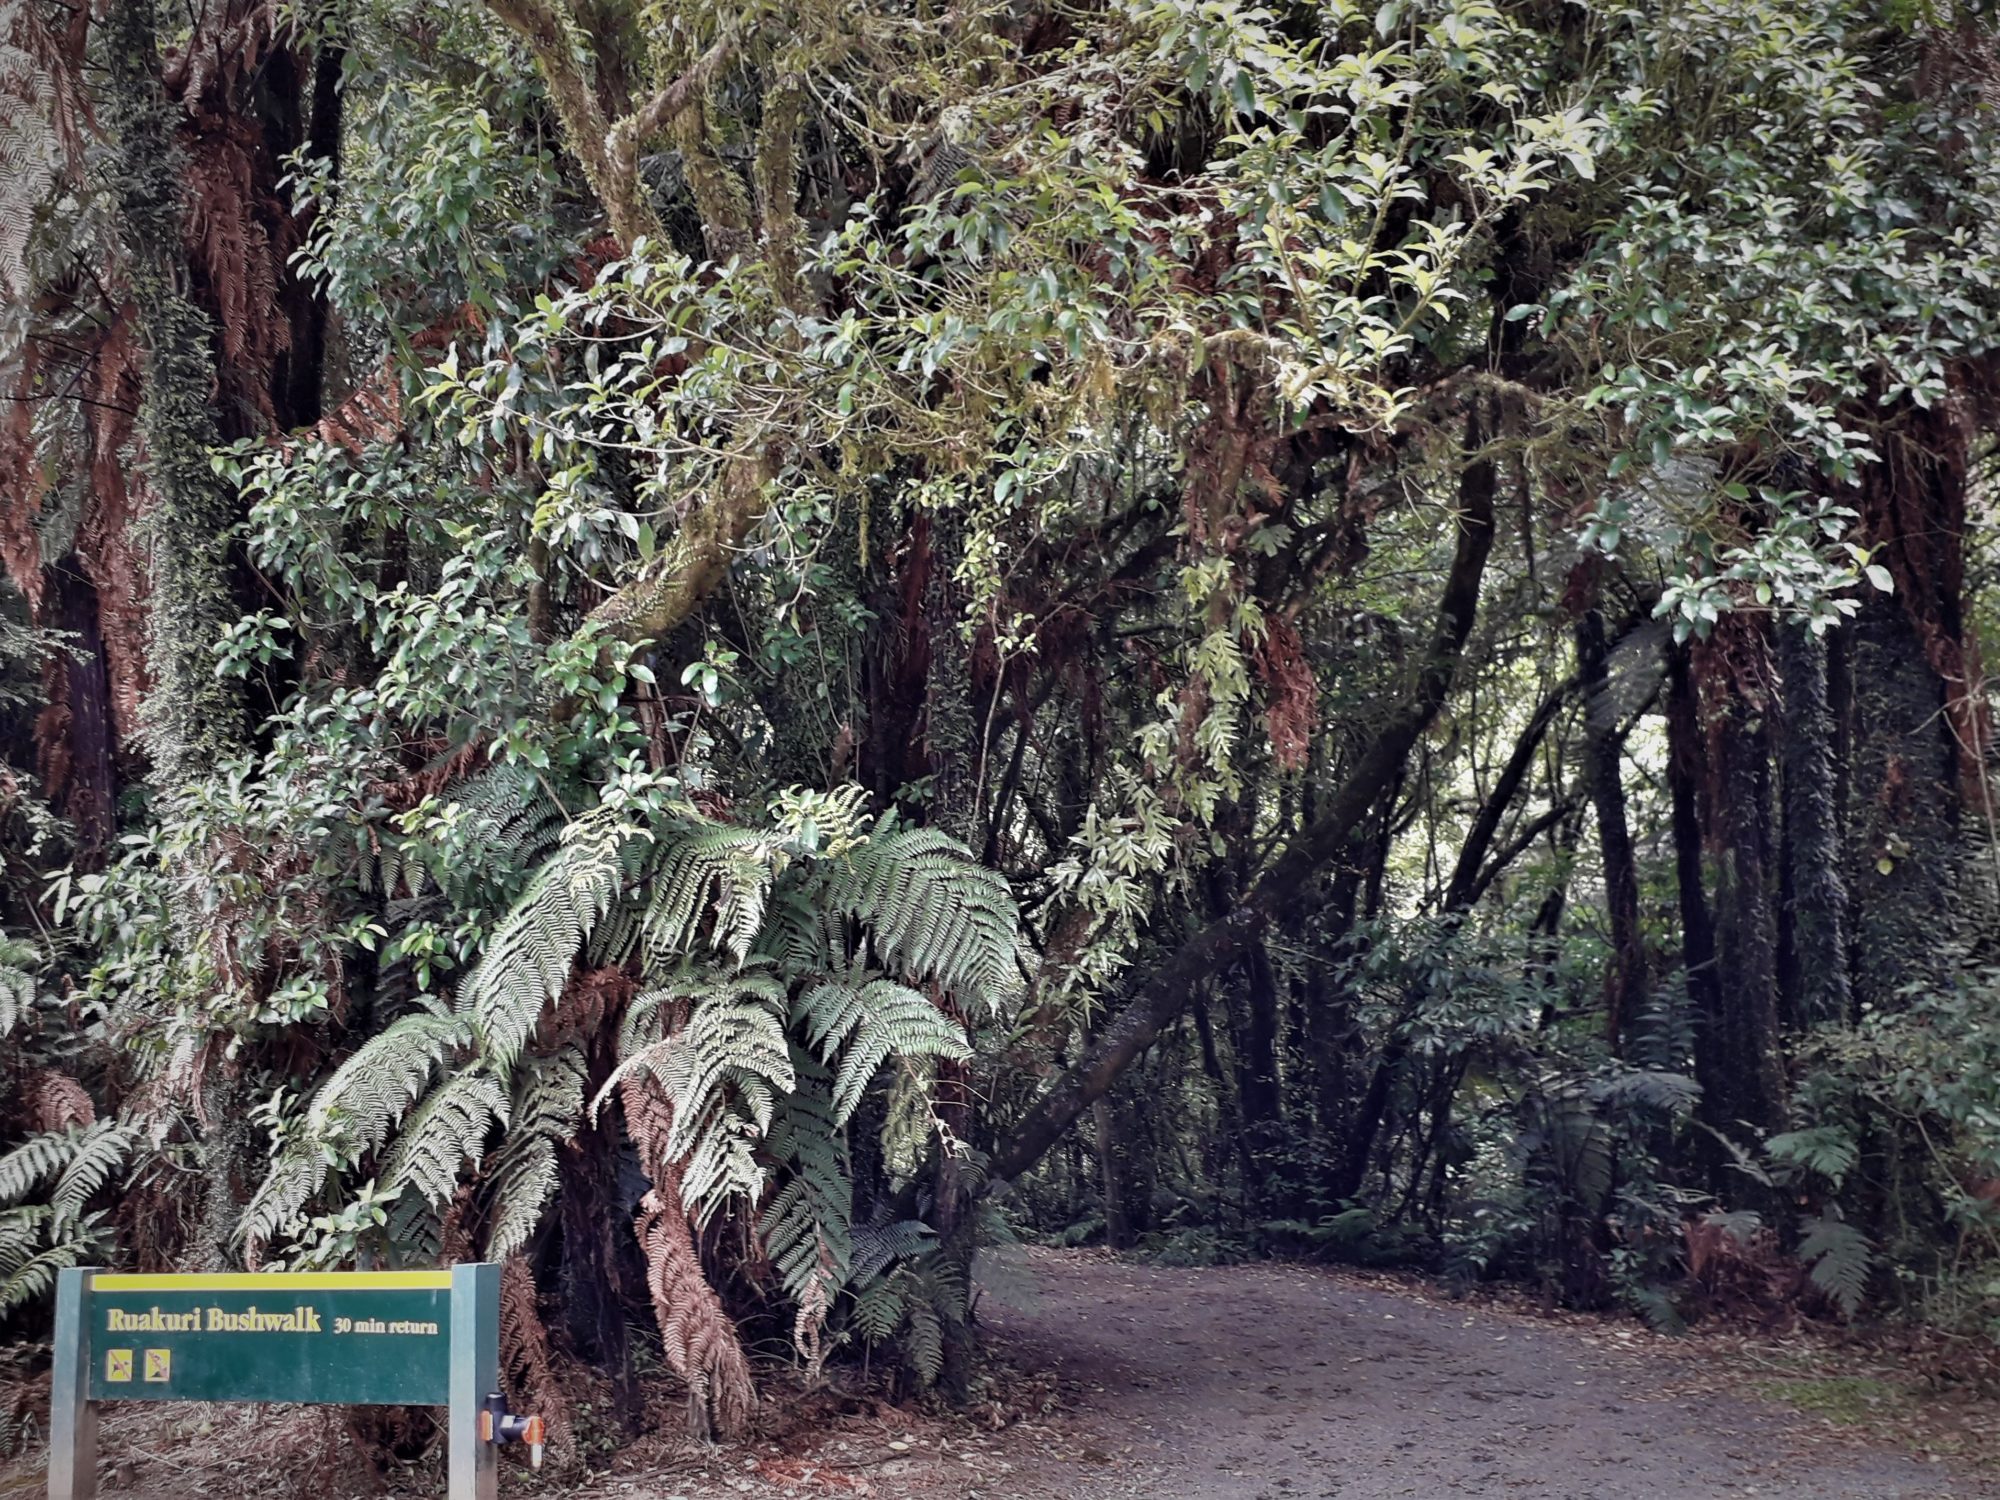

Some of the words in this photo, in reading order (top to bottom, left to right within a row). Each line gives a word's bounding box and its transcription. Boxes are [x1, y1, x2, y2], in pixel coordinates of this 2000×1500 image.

[107, 1306, 202, 1332] Ruakuri
[206, 1306, 321, 1332] Bushwalk
[333, 1318, 351, 1334] 30
[354, 1317, 386, 1334] min
[388, 1319, 438, 1335] return
